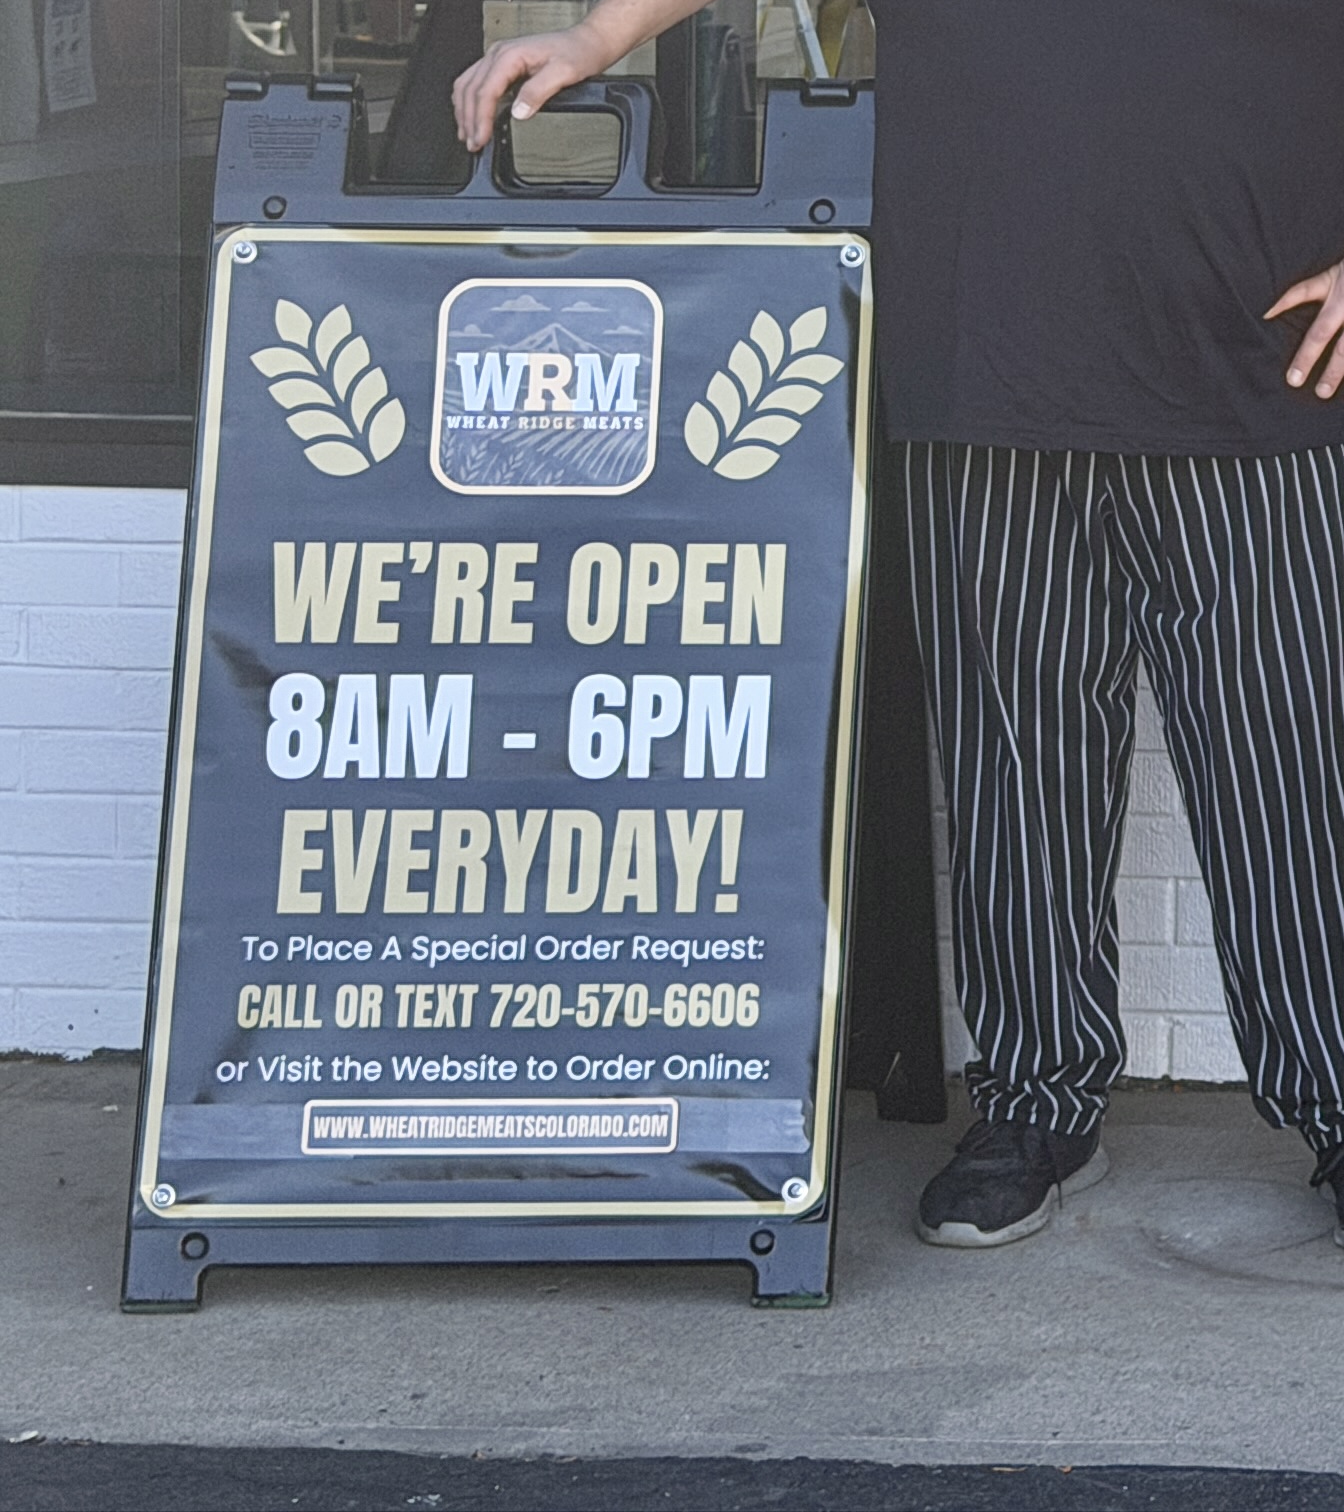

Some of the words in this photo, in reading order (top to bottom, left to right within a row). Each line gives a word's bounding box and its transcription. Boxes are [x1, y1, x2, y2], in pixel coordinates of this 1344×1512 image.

[455, 351, 641, 413] WRM
[446, 415, 510, 429] WHEAT
[518, 416, 576, 430] RIDGE
[582, 416, 644, 430] MEATS
[273, 541, 539, 644] WE'RE
[566, 542, 787, 645] OPEN
[265, 673, 474, 779] 8AM
[503, 733, 536, 749] -
[567, 673, 772, 779] 6PM
[276, 808, 744, 914] EVERYDAY!
[242, 936, 279, 961] To
[287, 935, 373, 961] Place
[380, 936, 402, 961] A
[411, 934, 527, 968] Special
[535, 934, 624, 961] Order
[631, 935, 765, 968] Request:
[237, 984, 323, 1029] CALL
[335, 984, 384, 1029] OR
[394, 984, 480, 1028] TEXT
[489, 983, 760, 1028] 720-570-6606
[216, 1060, 249, 1082] or
[257, 1054, 324, 1082] Visit
[331, 1054, 383, 1082] the
[391, 1054, 518, 1082] Website
[526, 1056, 558, 1081] to
[566, 1053, 656, 1081] Order
[663, 1053, 771, 1081] Online:
[313, 1114, 669, 1139] WWW.WHEATRIDGEMEATSCOLORADO.COM
